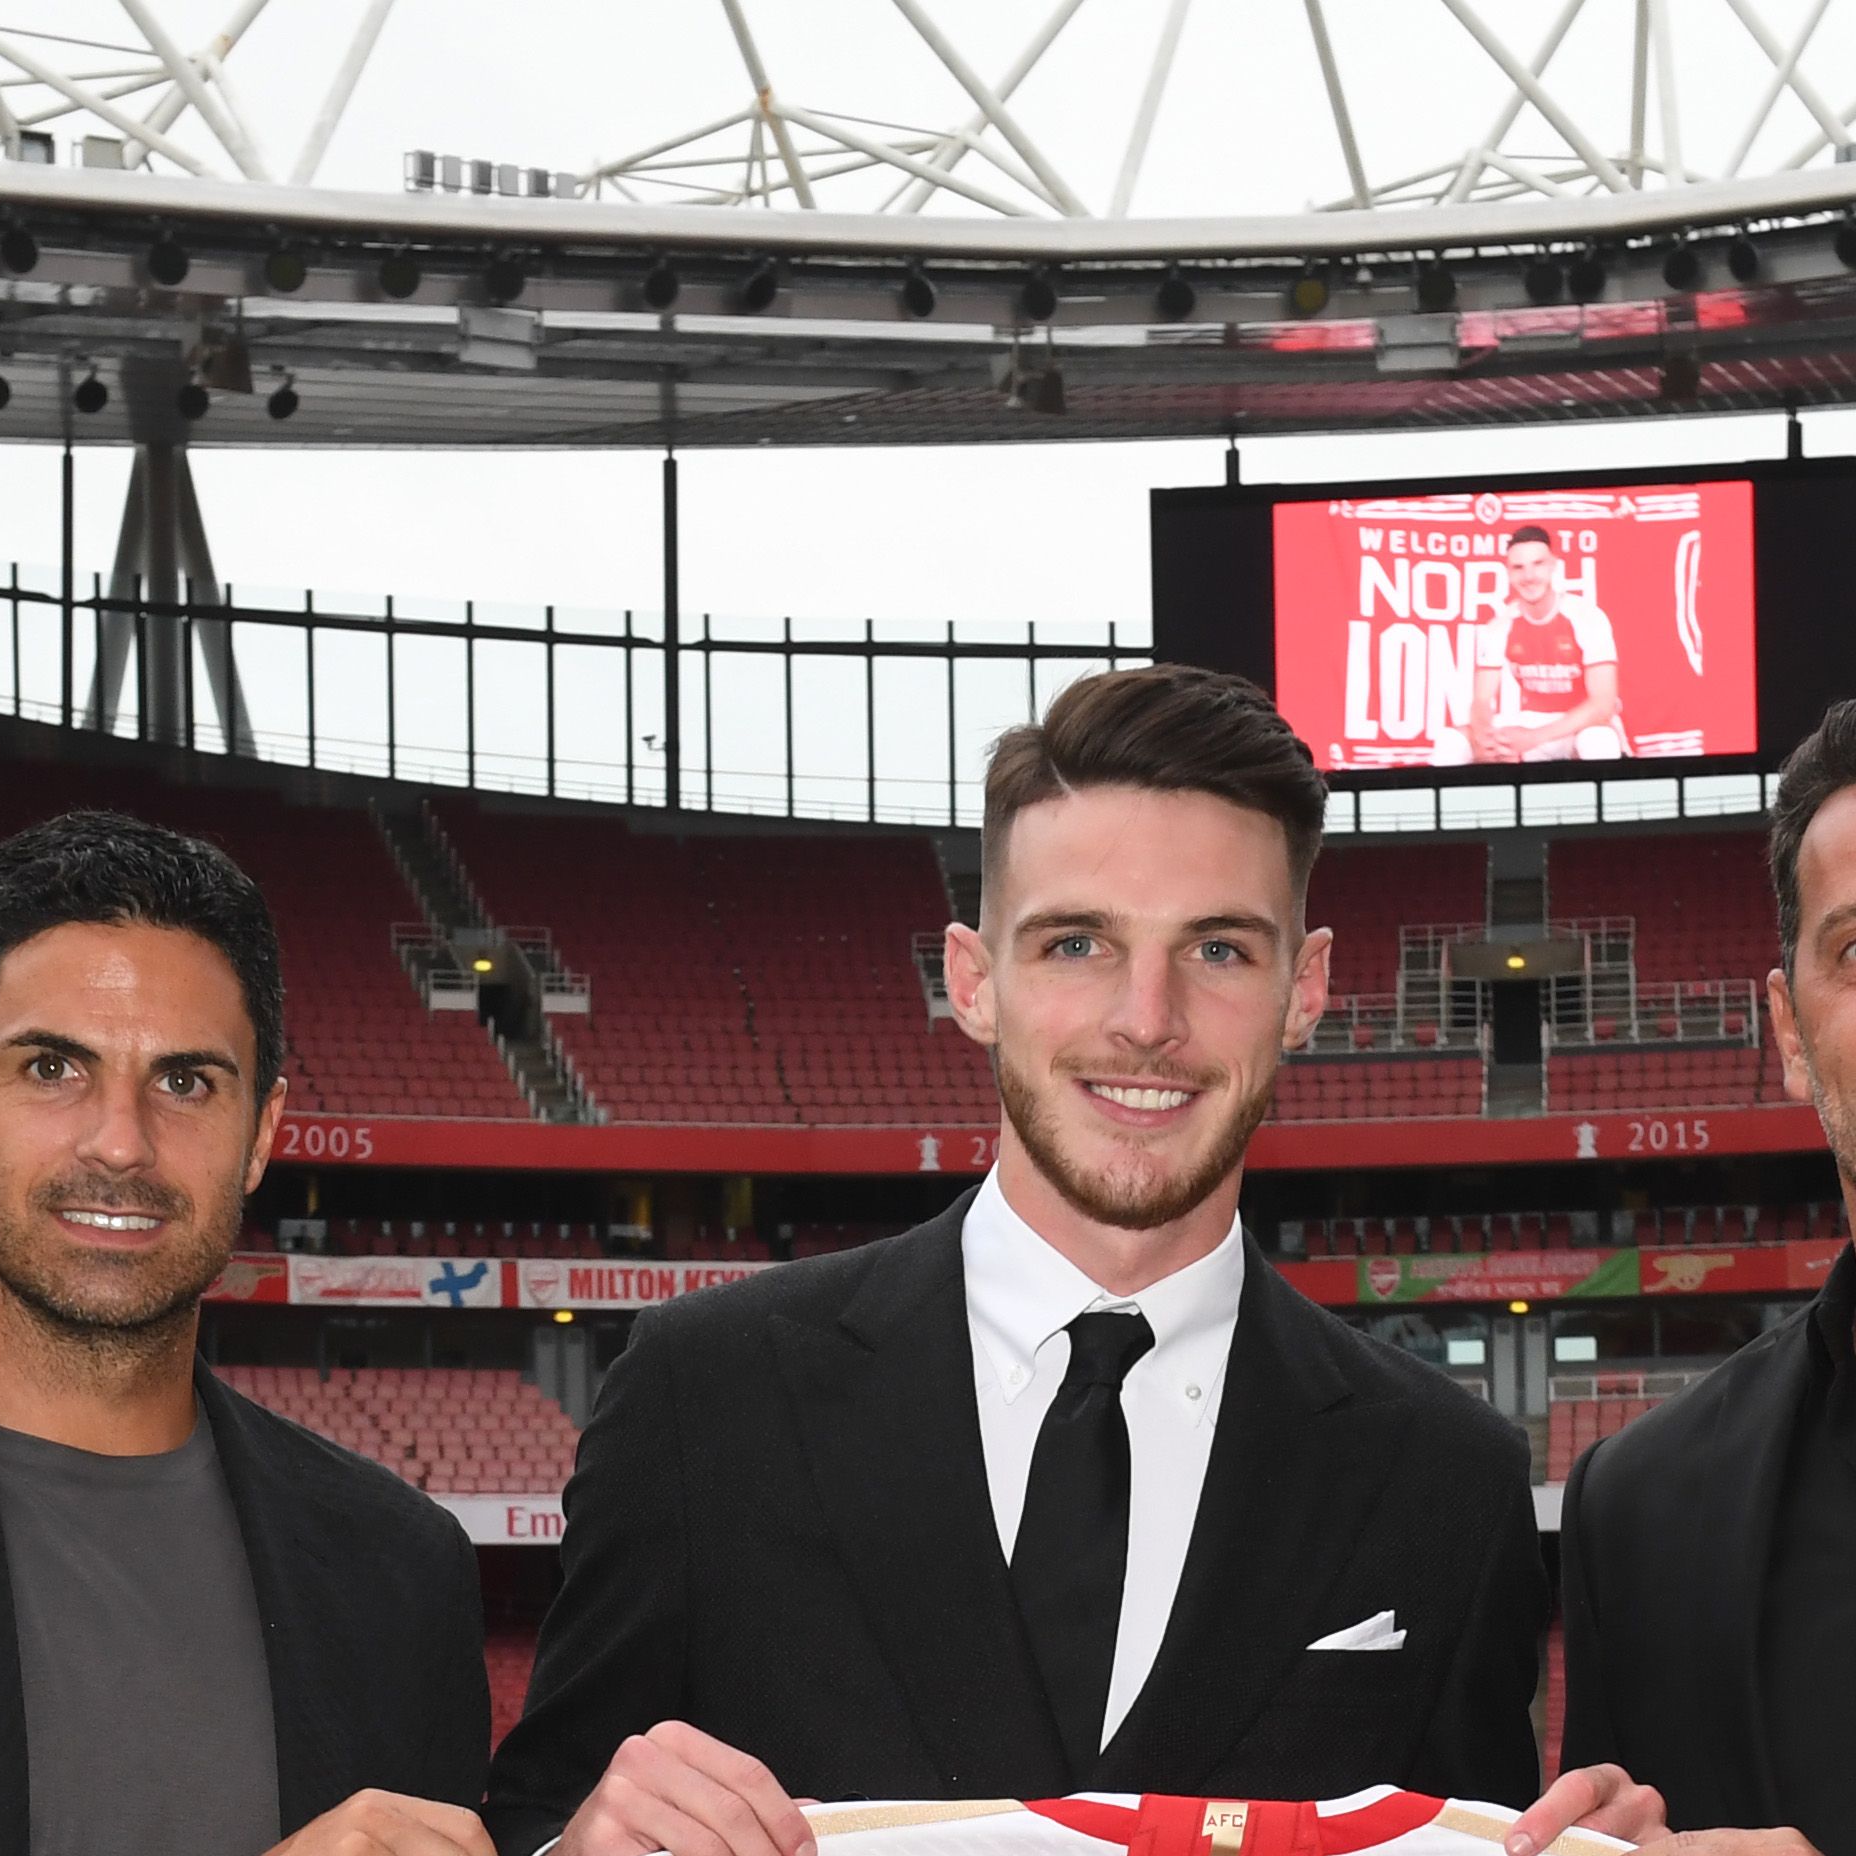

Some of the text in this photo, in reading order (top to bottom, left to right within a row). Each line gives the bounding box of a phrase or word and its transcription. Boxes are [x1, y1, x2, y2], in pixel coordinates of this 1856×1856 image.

[1359, 527, 1598, 557] WELCOME TO
[1359, 555, 1597, 621] NORH
[282, 1124, 374, 1159] 2005
[1627, 1120, 1709, 1151] 2015
[568, 1268, 675, 1300] MILTON
[1206, 1813, 1243, 1827] AFC
